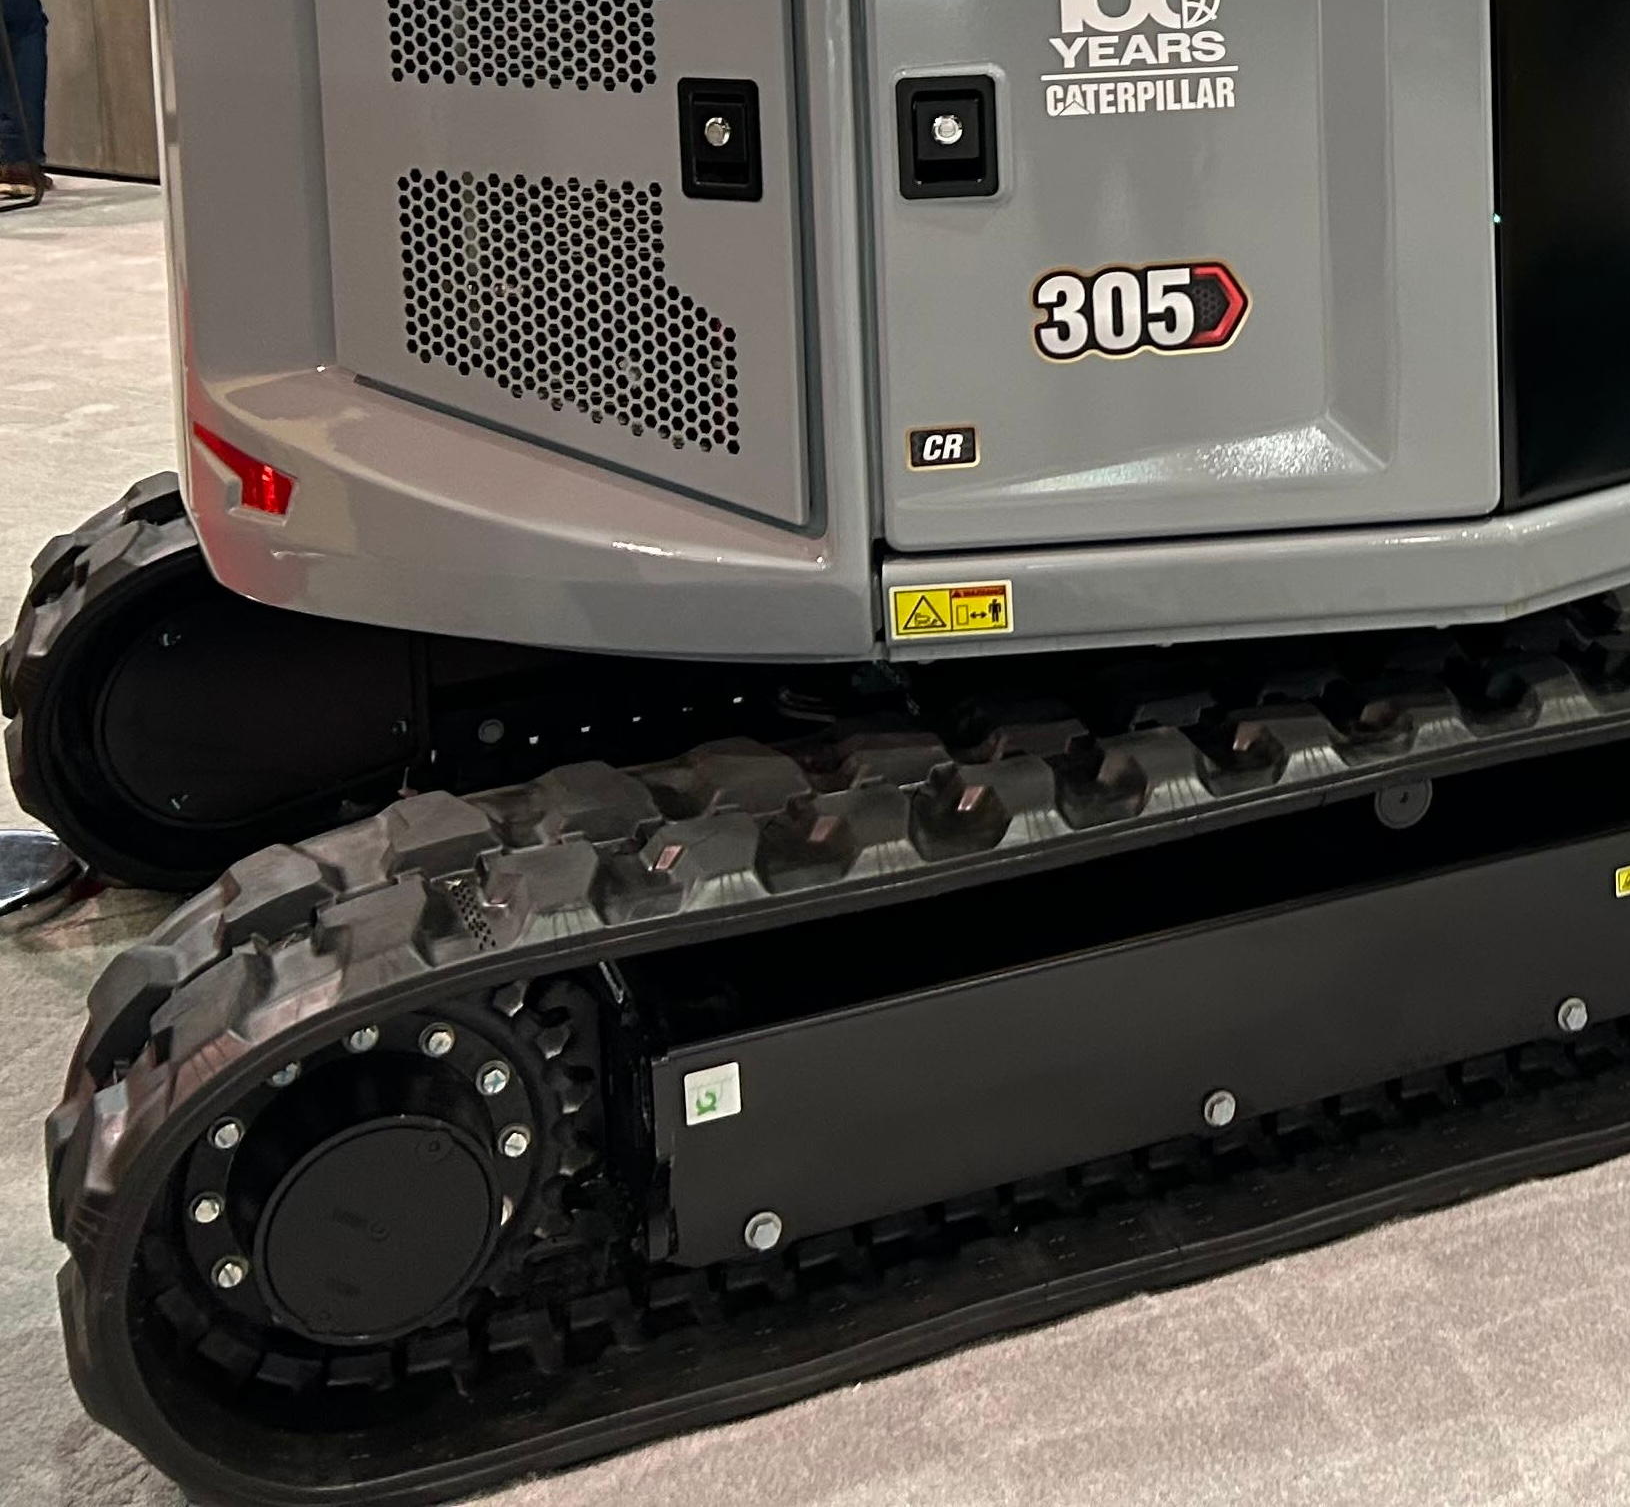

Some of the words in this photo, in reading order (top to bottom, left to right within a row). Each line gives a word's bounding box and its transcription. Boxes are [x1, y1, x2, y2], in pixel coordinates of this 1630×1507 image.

[1048, 30, 1226, 69] YEARS
[1045, 76, 1236, 118] CATERPILLAR
[1037, 267, 1197, 356] 305
[922, 433, 964, 462] CR
